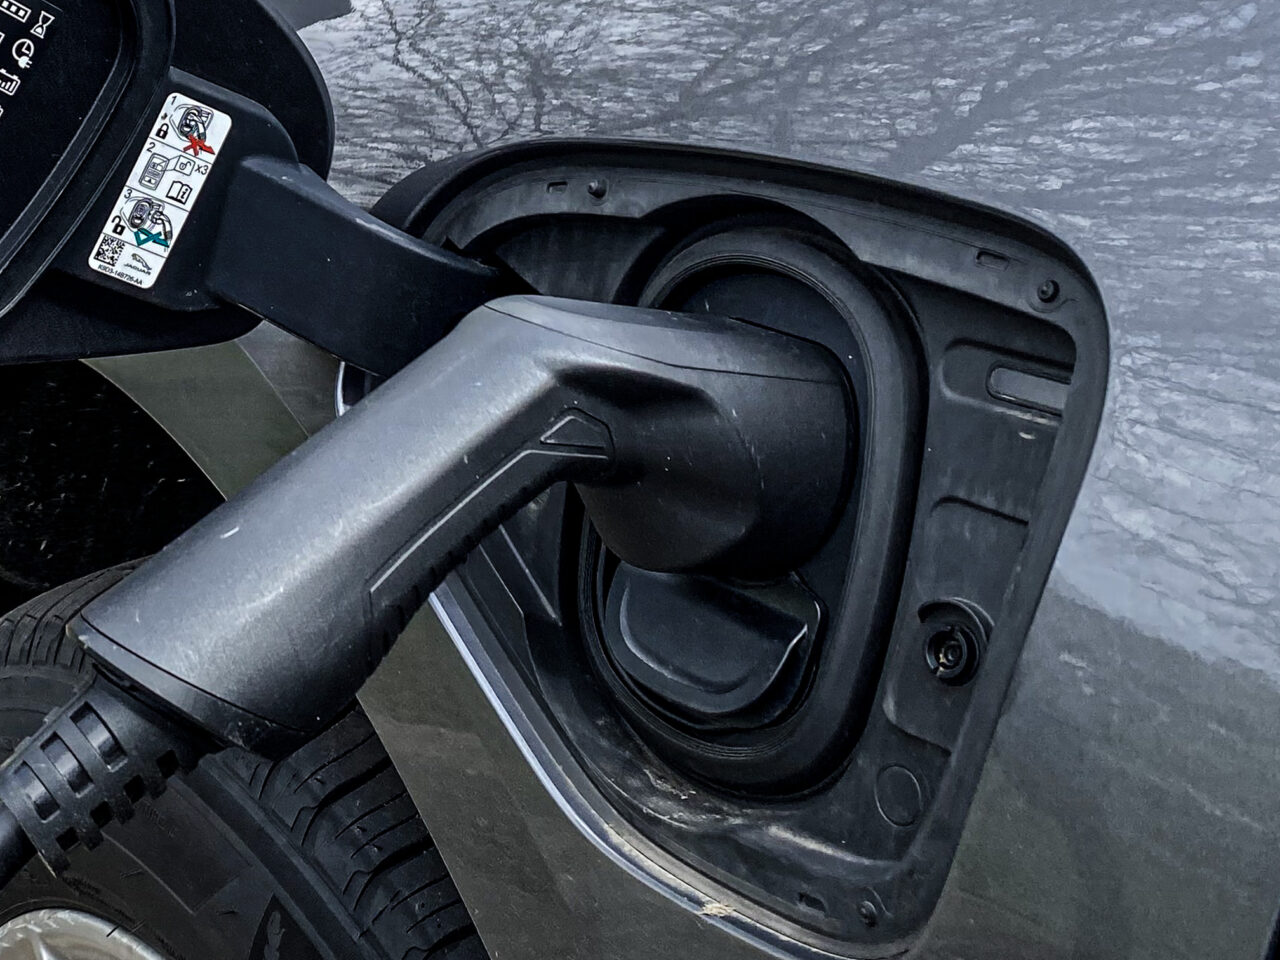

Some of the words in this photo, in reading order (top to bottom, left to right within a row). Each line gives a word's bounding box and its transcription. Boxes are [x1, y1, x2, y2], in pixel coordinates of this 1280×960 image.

[171, 95, 177, 105] 1
[146, 142, 155, 153] 2
[194, 164, 209, 175] x3
[124, 189, 133, 199] 3
[124, 263, 152, 276] JAGUAR
